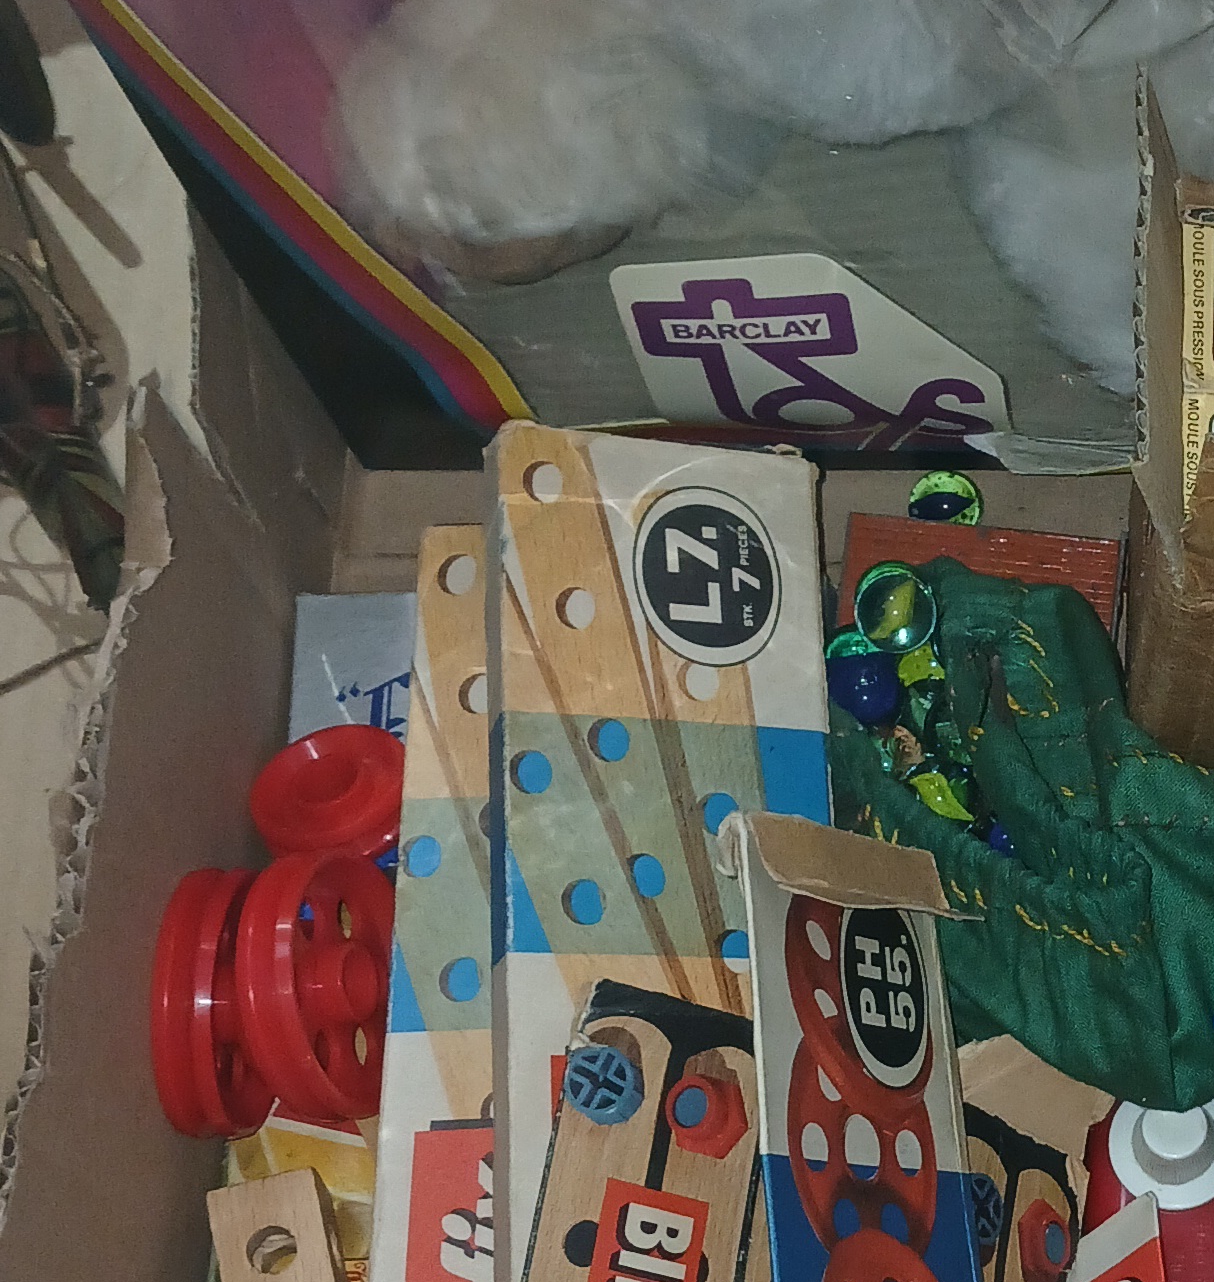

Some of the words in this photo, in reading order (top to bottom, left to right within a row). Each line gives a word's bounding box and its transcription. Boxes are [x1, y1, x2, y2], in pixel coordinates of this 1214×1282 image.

[1193, 270, 1205, 308] SOUS
[670, 317, 822, 341] BARCLAY
[1192, 310, 1206, 381] PRESSION
[1186, 398, 1199, 449] MOULE
[1185, 451, 1198, 490] SOUS
[737, 525, 750, 566] PIECES
[731, 567, 761, 591] 7
[855, 936, 887, 1028] PH
